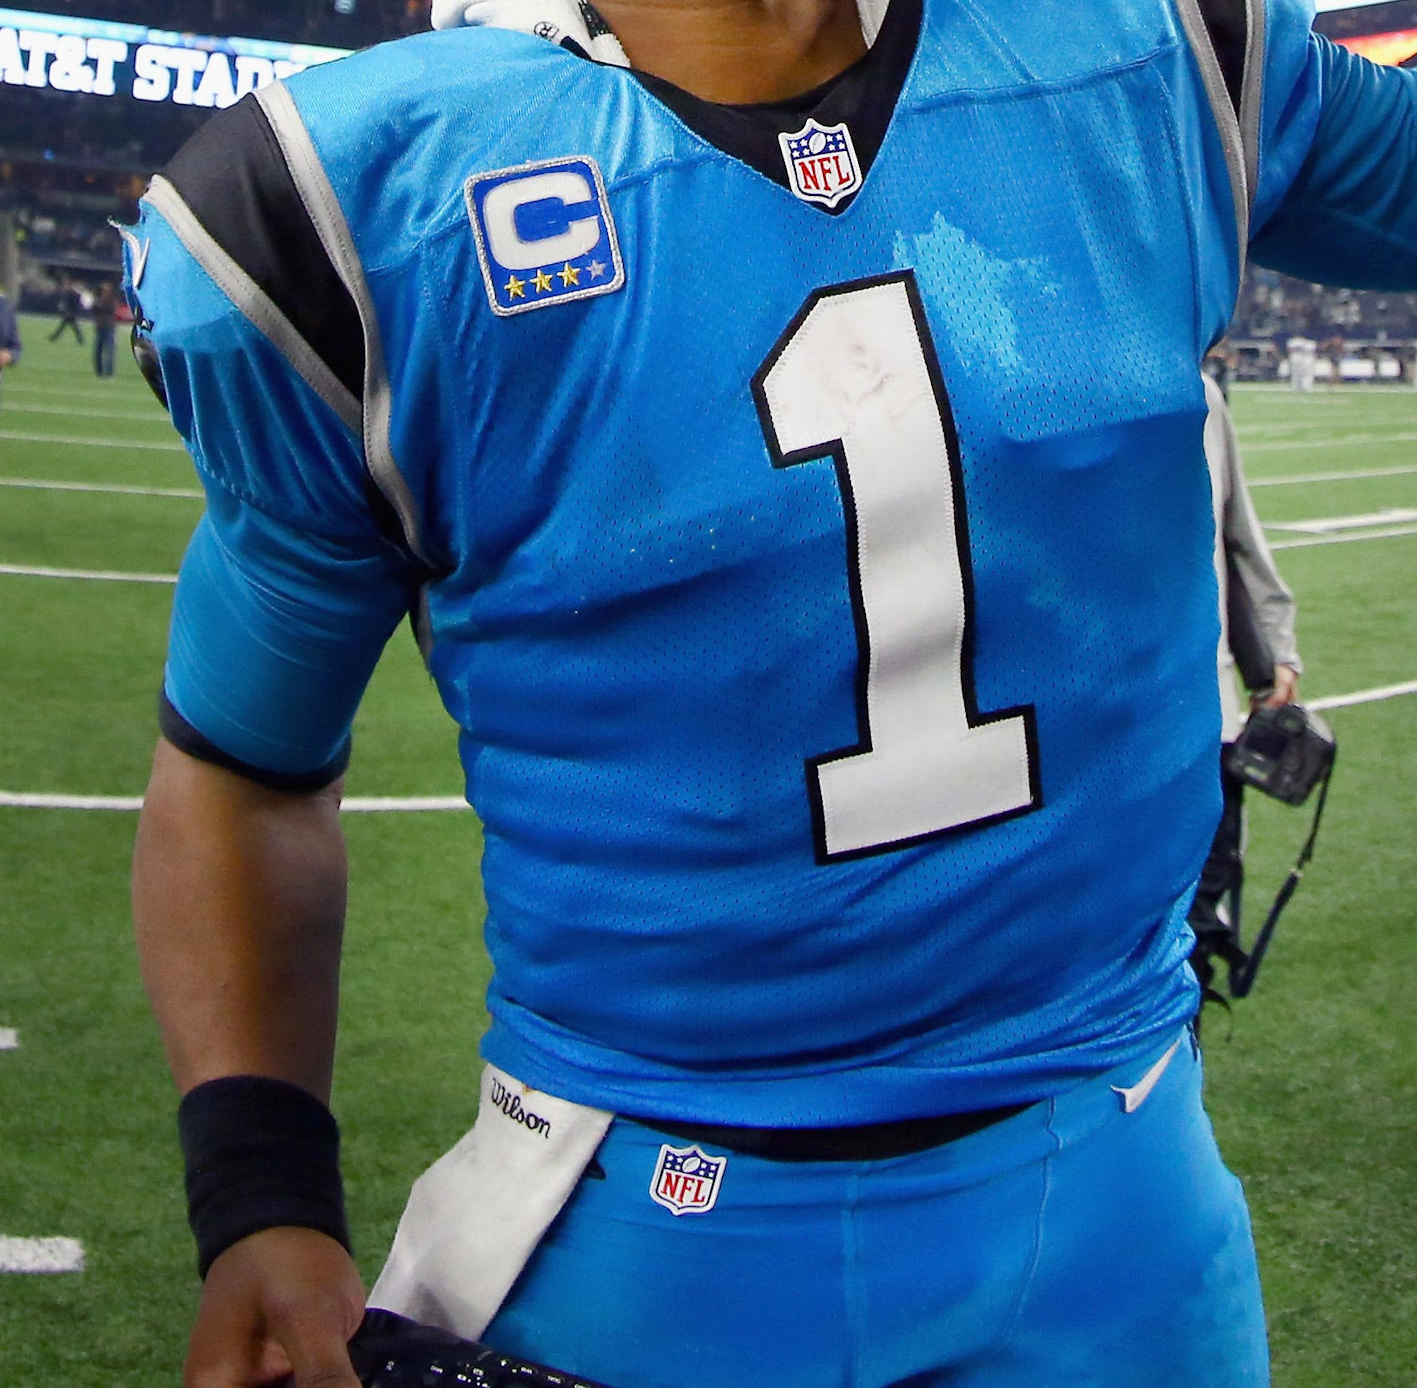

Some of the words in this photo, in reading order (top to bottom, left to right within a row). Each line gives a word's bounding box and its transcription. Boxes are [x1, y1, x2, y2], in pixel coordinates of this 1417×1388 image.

[133, 43, 310, 110] STAD
[798, 155, 851, 192] NFL
[483, 171, 600, 271] C
[750, 268, 1045, 867] 1
[491, 1077, 551, 1139] Wilson
[660, 1171, 706, 1205] NFL
